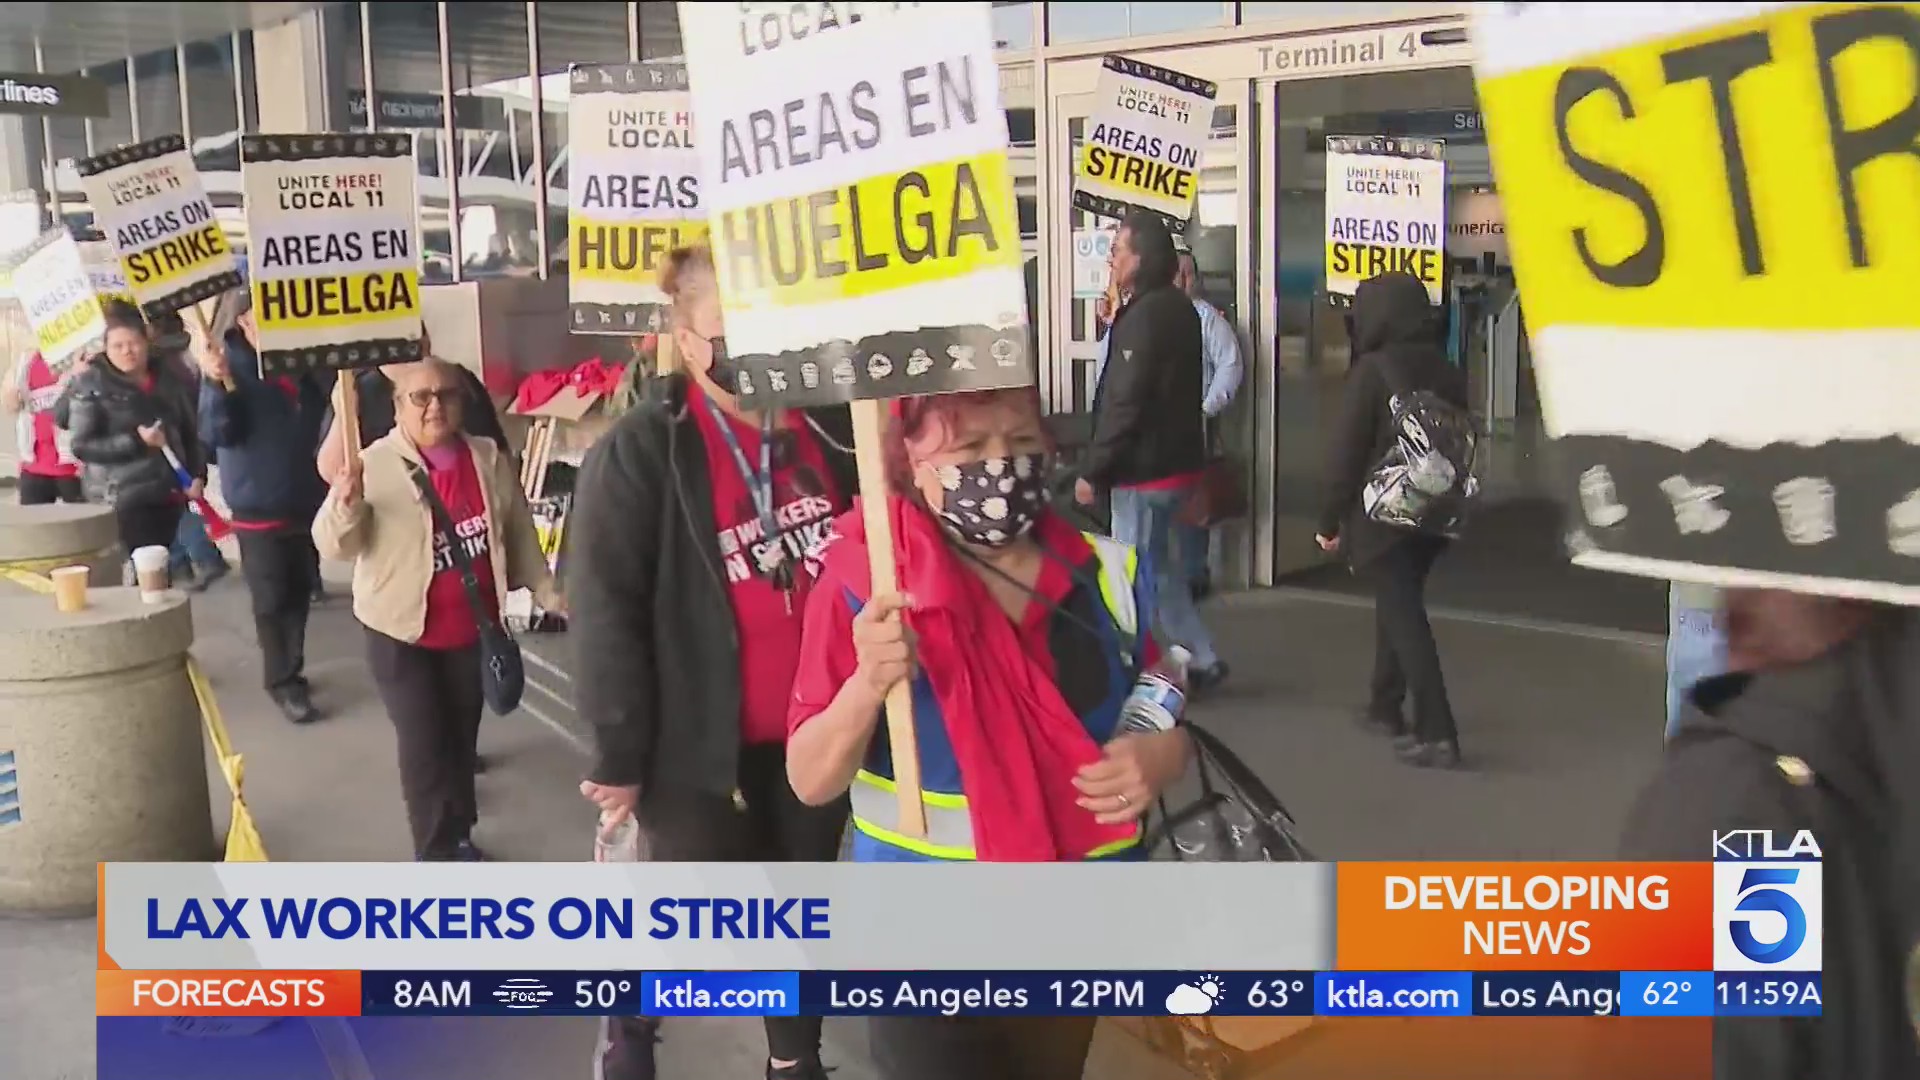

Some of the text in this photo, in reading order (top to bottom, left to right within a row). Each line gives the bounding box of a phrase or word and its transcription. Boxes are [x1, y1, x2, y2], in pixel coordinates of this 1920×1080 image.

[1258, 32, 1417, 71] Terminal 4
[1117, 96, 1190, 124] LOCAL 11
[1119, 84, 1155, 101] UNITE
[608, 110, 668, 126] UNITE
[721, 54, 978, 183] AREAS EN
[608, 128, 695, 149] LOCAL
[1092, 123, 1198, 168] AREAS ON
[278, 174, 382, 190] UNITE HERE!
[582, 173, 699, 209] AREAS
[1087, 146, 1192, 200] STRIKE
[1346, 180, 1421, 198] LOCAL 11
[279, 190, 384, 210] LOCAL 11
[116, 199, 211, 250] AREAS ON
[722, 162, 999, 289] HUELGA
[1331, 217, 1437, 246] AREAS ON
[126, 226, 224, 283] STRIKE
[261, 228, 409, 268] AREAS EN
[1332, 242, 1437, 282] STRIKE
[260, 272, 413, 322] HUELGA
